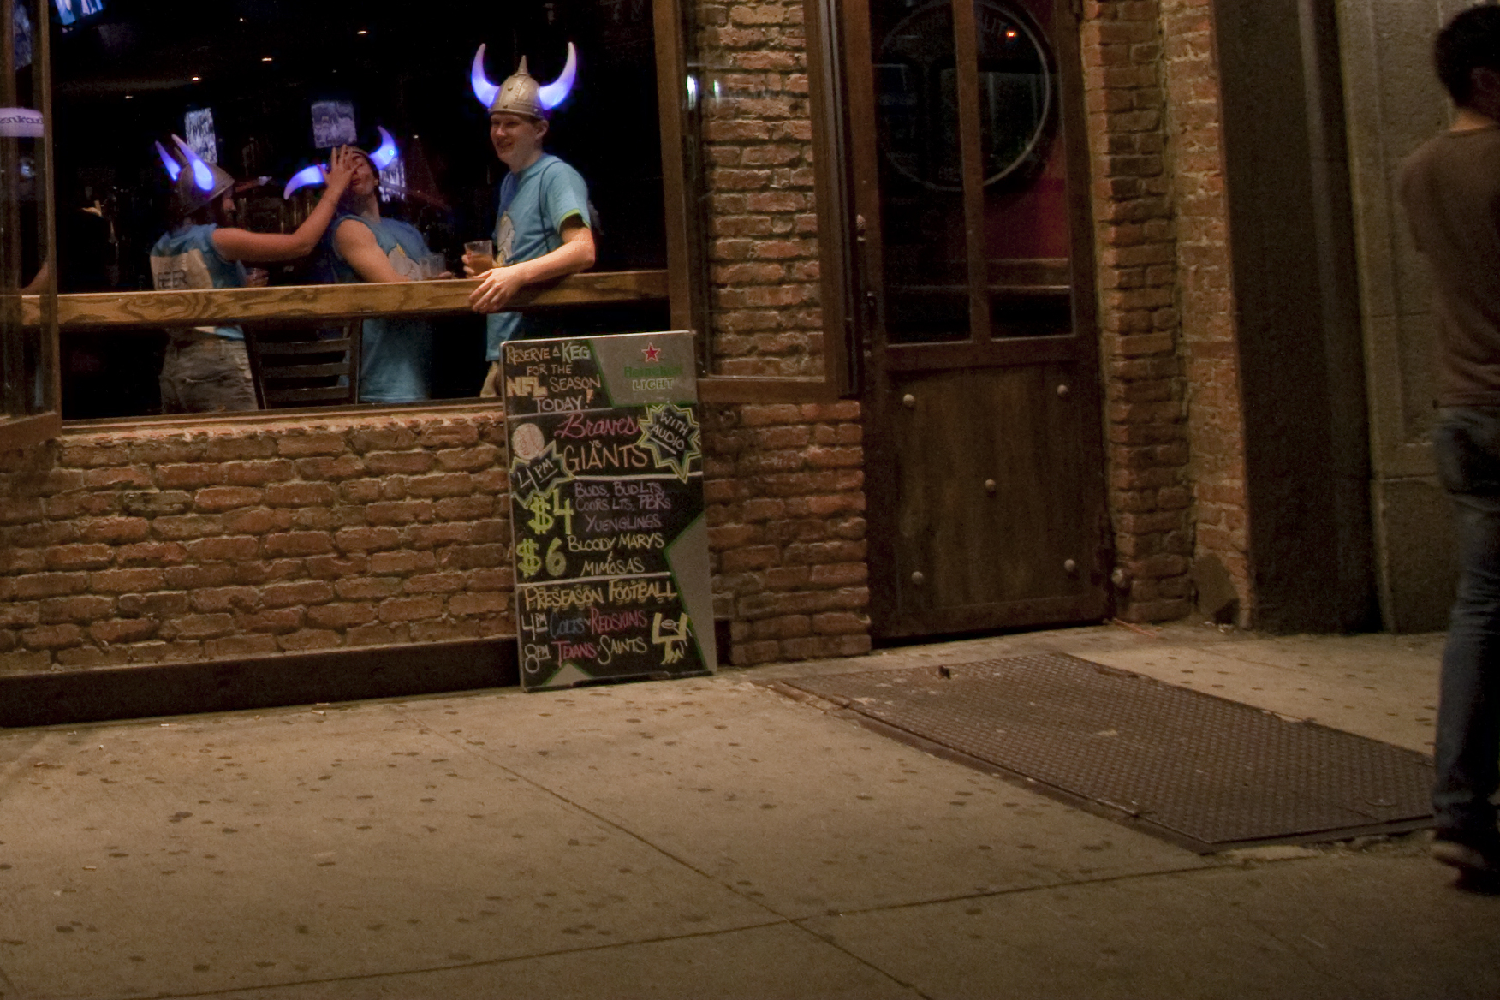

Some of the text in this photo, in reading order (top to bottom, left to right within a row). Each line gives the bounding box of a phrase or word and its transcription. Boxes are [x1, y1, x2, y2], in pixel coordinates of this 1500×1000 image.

[506, 342, 591, 365] RESERVE A KEG
[526, 363, 572, 376] FOR THE
[506, 374, 601, 397] NFL SEASON
[632, 377, 675, 391] LIGHT
[554, 412, 640, 439] Braves
[660, 412, 688, 437] WITH
[563, 442, 648, 475] GIANTS
[575, 498, 610, 511] COORS
[567, 532, 665, 552] BLOODY MARYS
[580, 556, 646, 577] MIMOSAS
[525, 580, 678, 611] PRESEASON FOOTBALL
[549, 612, 586, 640] COLTS
[591, 607, 648, 635] REDSKINS
[550, 640, 598, 668] TEXANS
[598, 634, 648, 666] SAINTS
